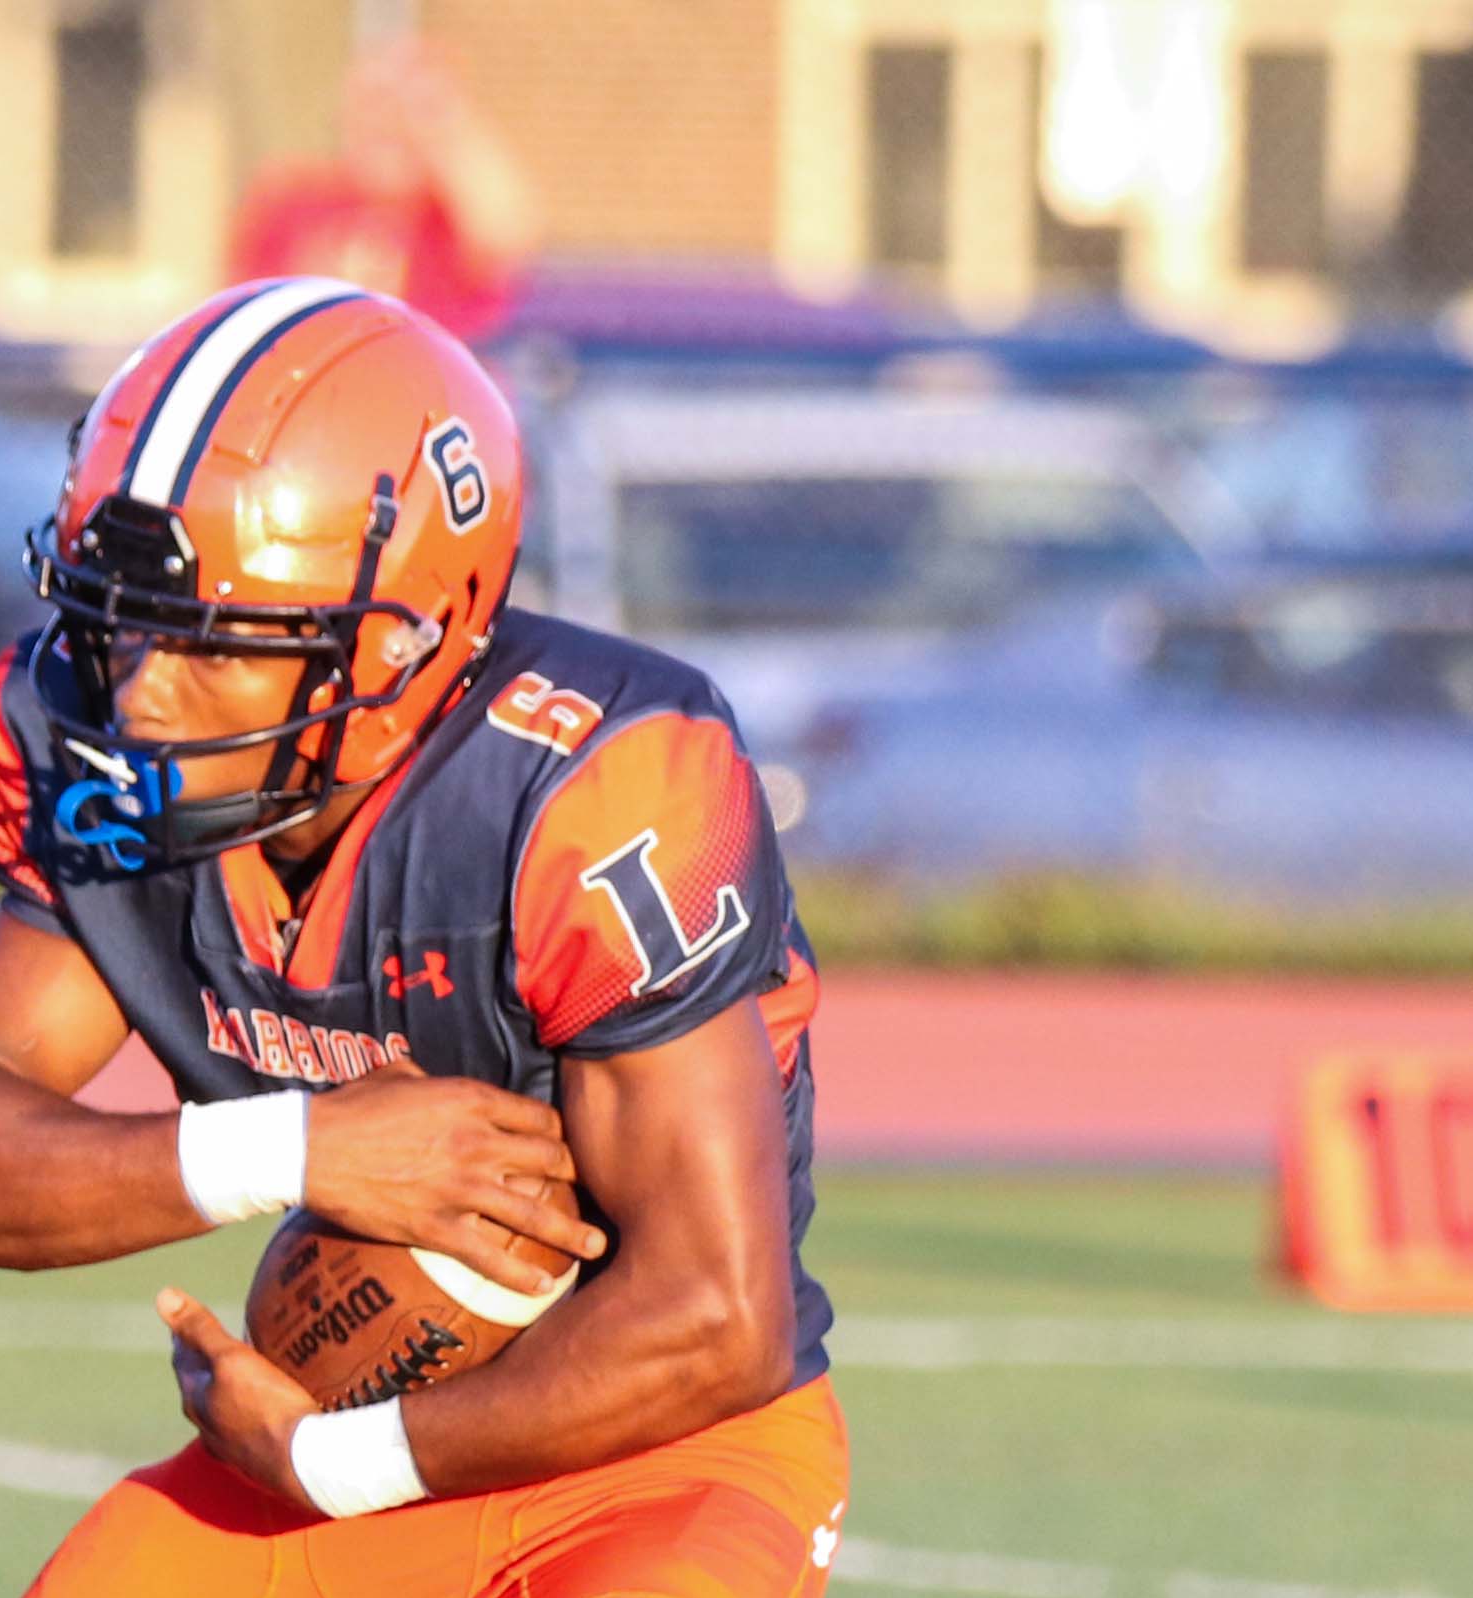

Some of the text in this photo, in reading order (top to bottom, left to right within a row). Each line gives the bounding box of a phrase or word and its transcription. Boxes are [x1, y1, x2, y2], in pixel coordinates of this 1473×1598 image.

[423, 415, 491, 537] 6
[486, 671, 604, 757] 6
[579, 827, 751, 998] L
[284, 1276, 396, 1368] Wilson
